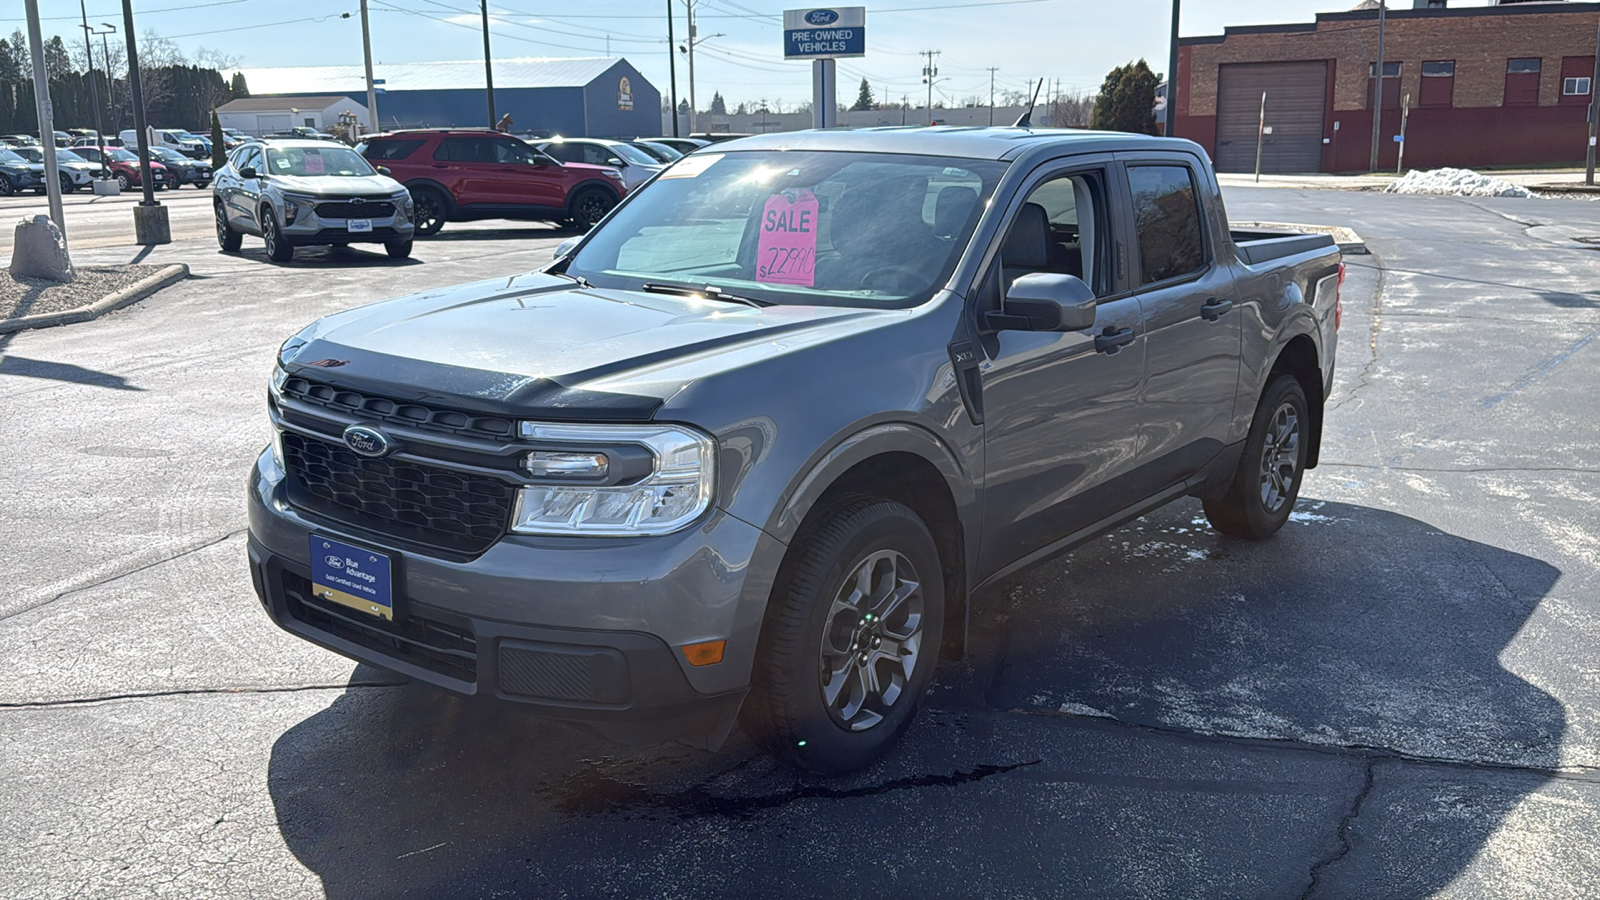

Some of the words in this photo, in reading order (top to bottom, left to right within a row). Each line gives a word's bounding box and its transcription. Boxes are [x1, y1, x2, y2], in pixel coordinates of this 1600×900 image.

[810, 12, 831, 23] Ford
[798, 41, 846, 53] VEHICLES
[765, 209, 811, 233] SALE
[351, 432, 375, 451] Ford
[328, 556, 342, 568] Ford
[345, 557, 359, 569] Blue
[345, 566, 376, 584] Advantage
[325, 573, 335, 582] Gold
[335, 576, 351, 587] Certified
[351, 582, 362, 590] Used
[362, 586, 376, 595] Vehicle
